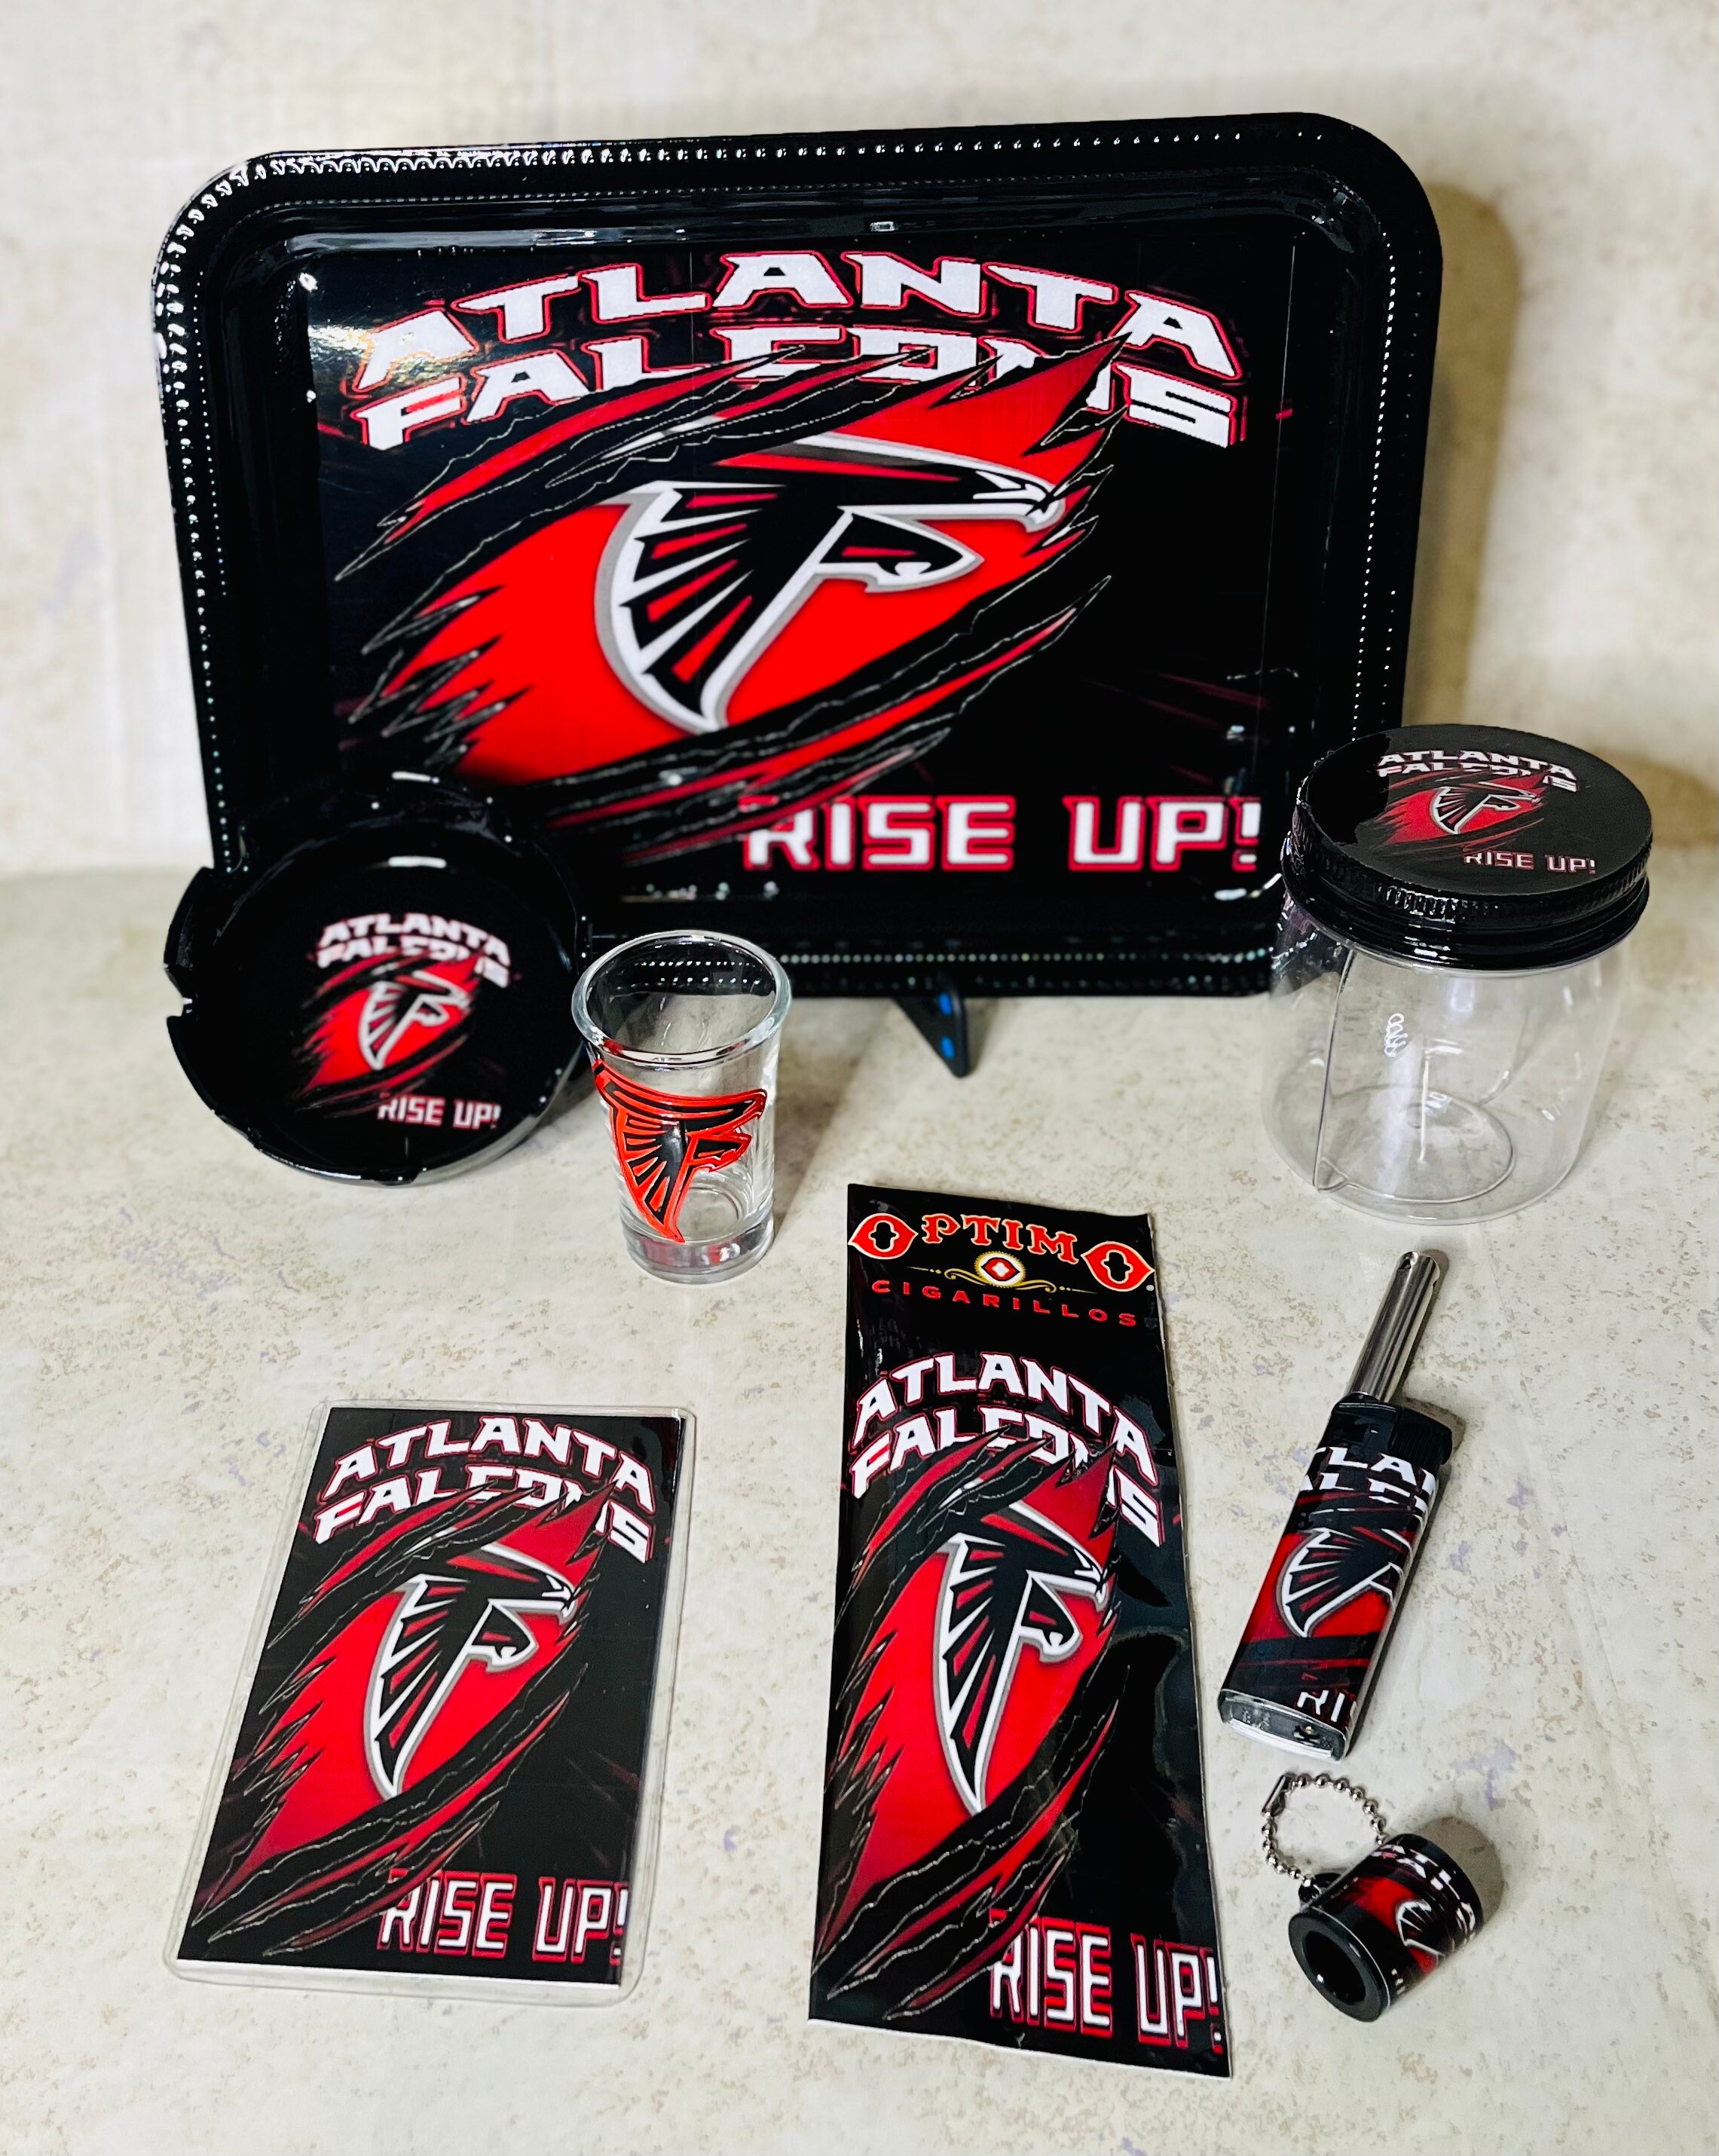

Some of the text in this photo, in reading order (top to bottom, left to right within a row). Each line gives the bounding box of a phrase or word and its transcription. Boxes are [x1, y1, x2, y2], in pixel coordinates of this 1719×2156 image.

[348, 251, 1242, 394] ATLANTA
[1377, 750, 1577, 781] ATLANTA
[740, 796, 1262, 871] RISE UP!
[1463, 849, 1596, 874] RISE UP!
[317, 912, 510, 967] ATLANTA
[378, 1091, 501, 1130] RISE UP!
[848, 1213, 1155, 1292] OPTIMO
[872, 1280, 1136, 1327] CIGARILLOS
[849, 1352, 1159, 1486] ATLANTA
[317, 1416, 655, 1515] ATLANTA
[377, 1868, 629, 1966] RISE UP!
[989, 1908, 1223, 2055] RISE UP!
